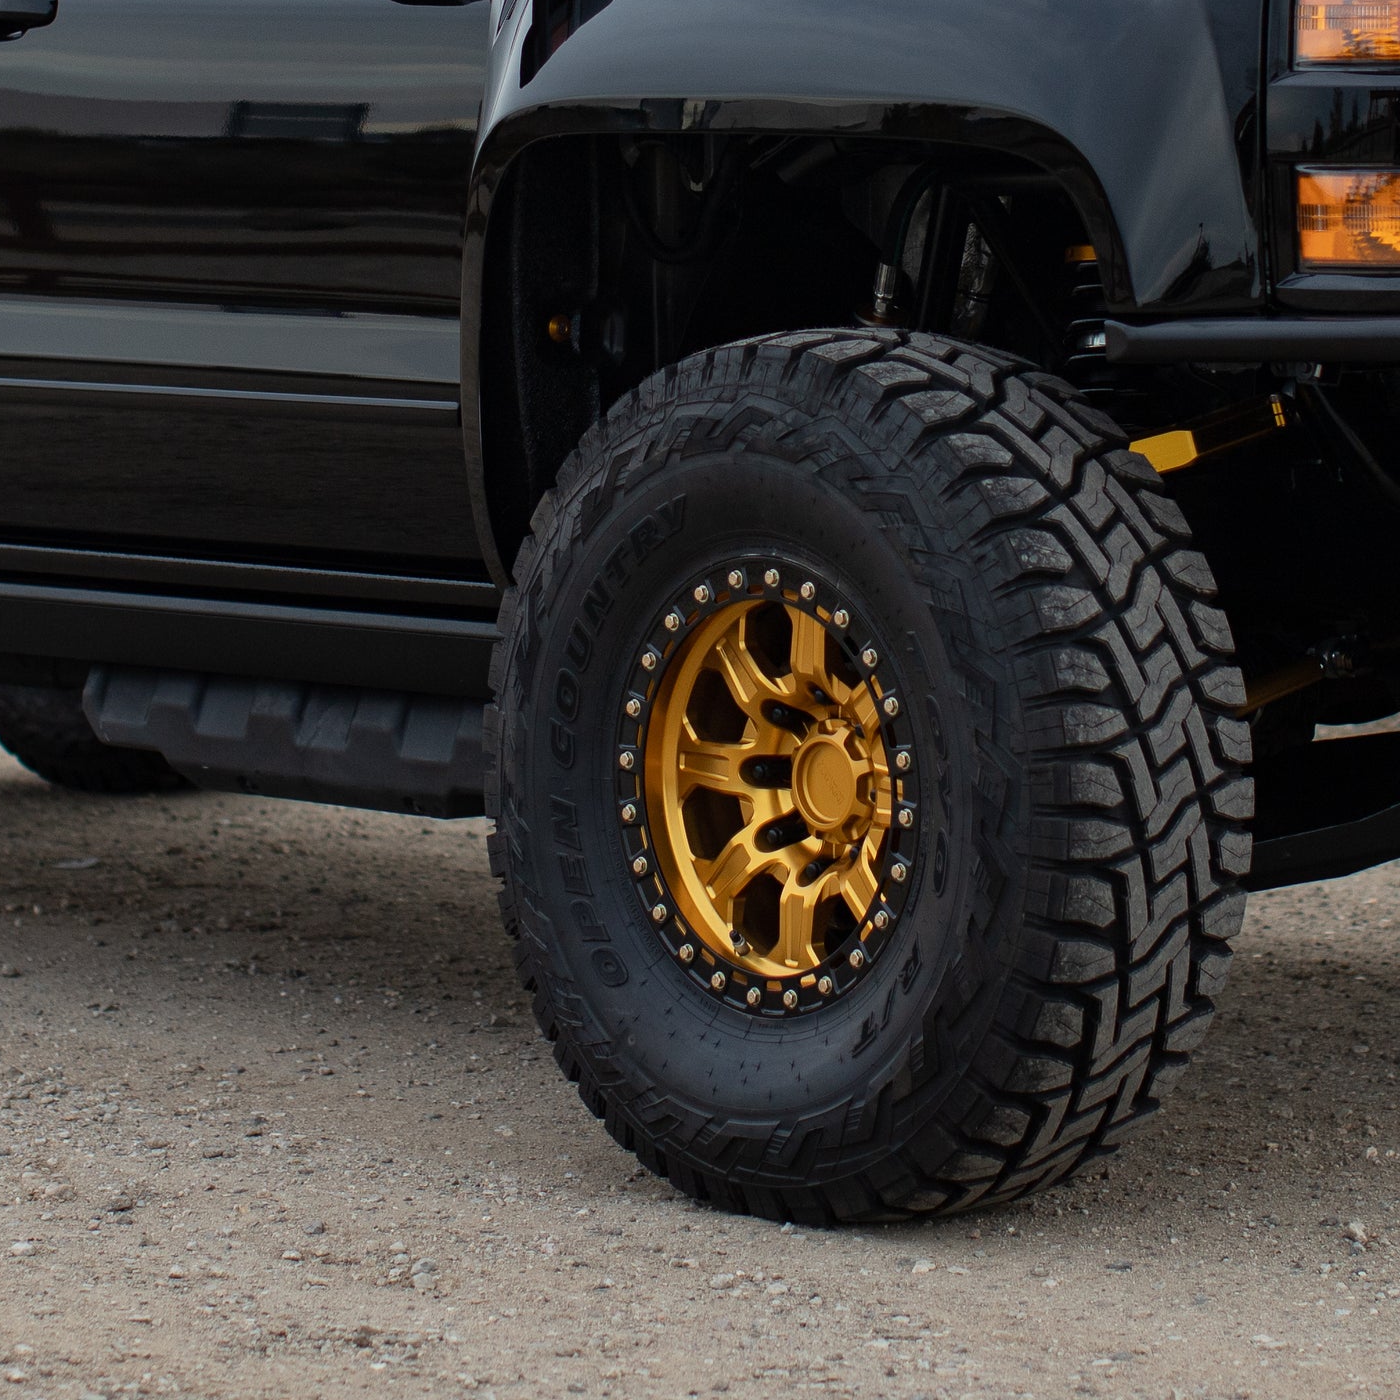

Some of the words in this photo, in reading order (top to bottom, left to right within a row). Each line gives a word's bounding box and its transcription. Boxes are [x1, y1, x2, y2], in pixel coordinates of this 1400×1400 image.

[548, 492, 687, 770] COUNTRY
[904, 629, 953, 899] TOYO
[548, 793, 630, 989] OPEN
[848, 930, 924, 1060] R/T
